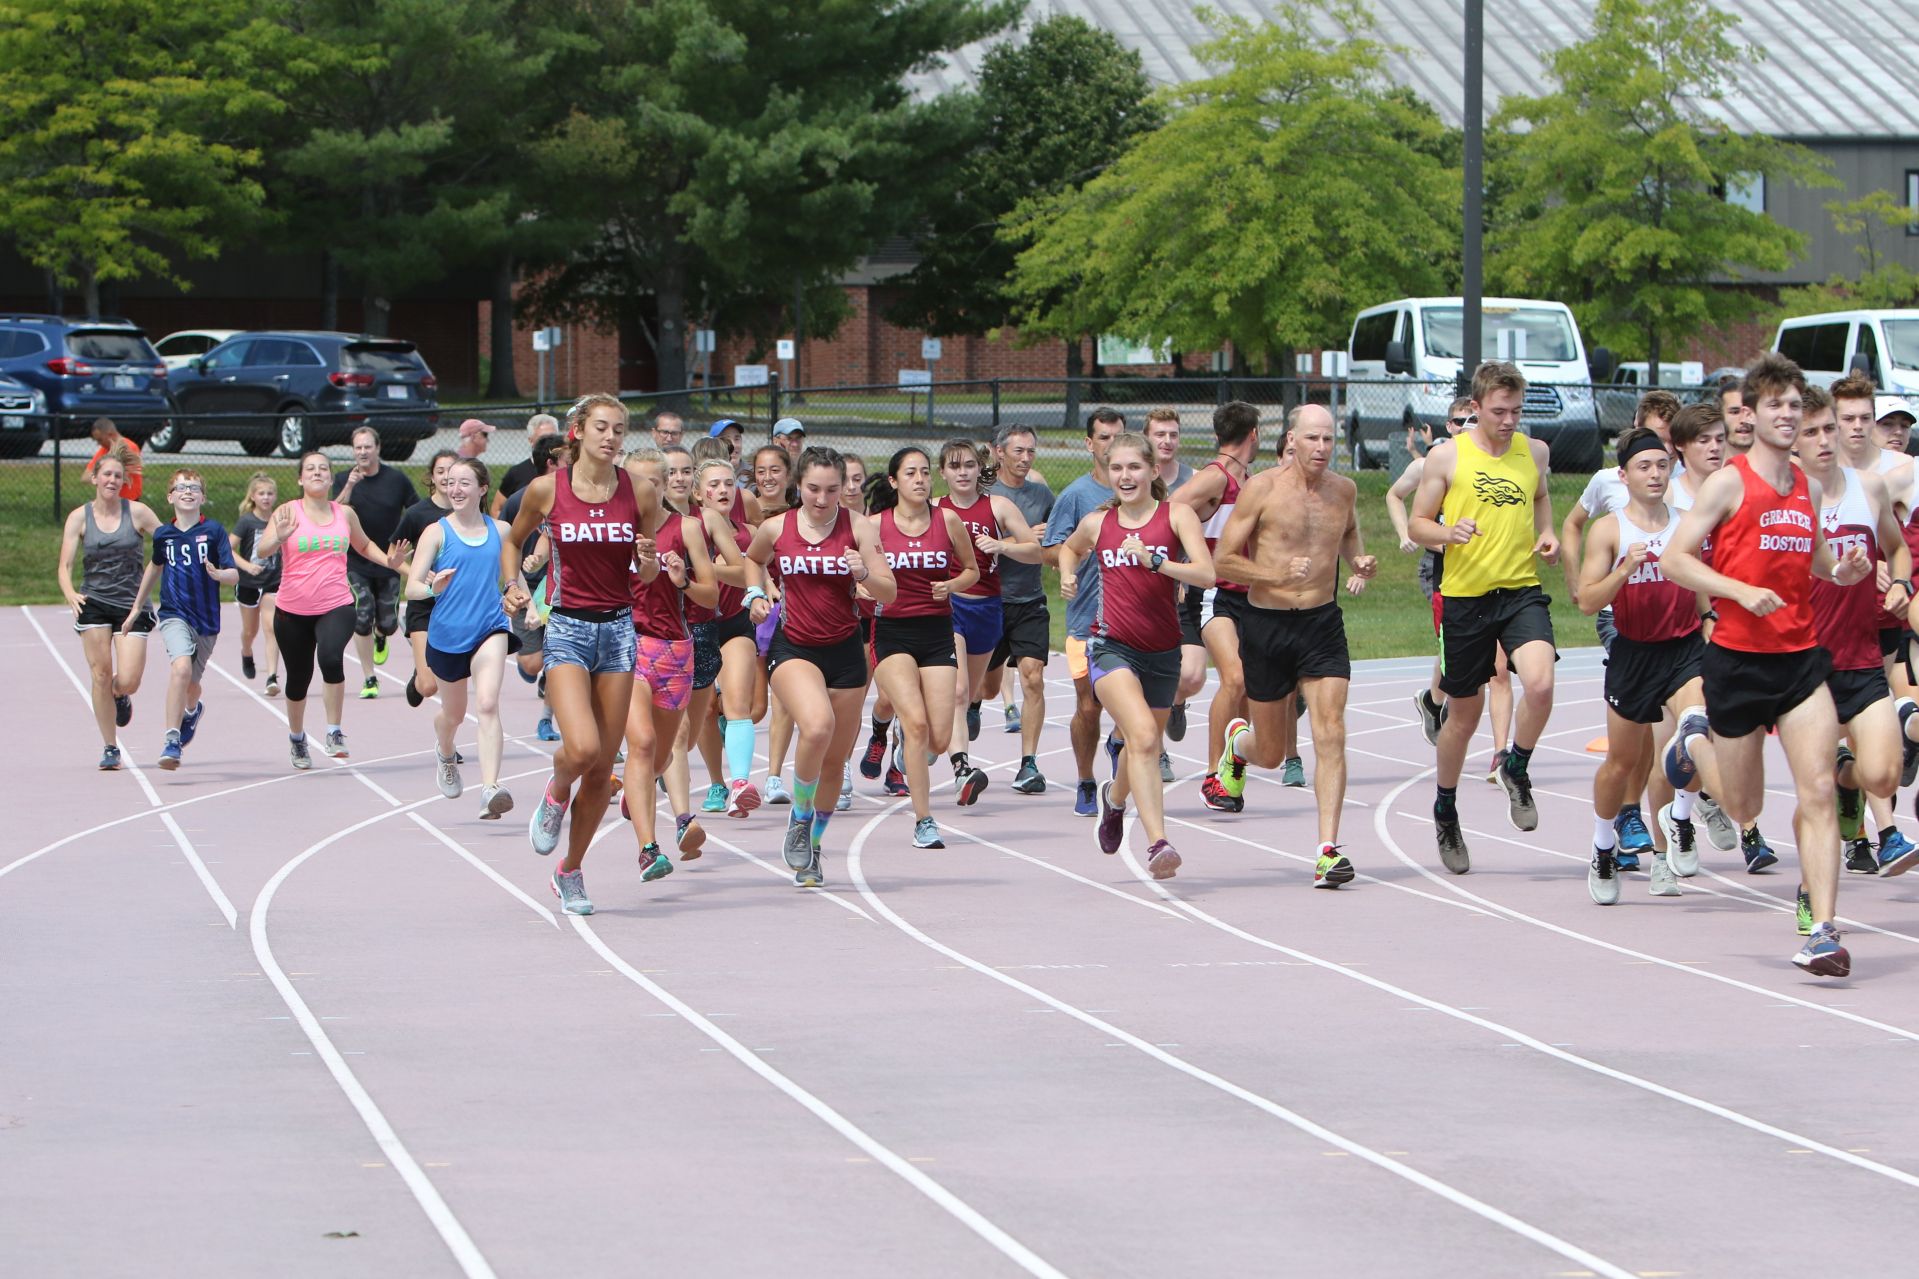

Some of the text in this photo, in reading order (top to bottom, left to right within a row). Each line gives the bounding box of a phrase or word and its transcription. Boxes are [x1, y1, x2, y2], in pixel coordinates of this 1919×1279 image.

[1760, 509, 1812, 532] GREATER
[560, 522, 634, 542] BATES
[1759, 534, 1812, 553] BOSTON
[166, 542, 208, 567] USA
[884, 551, 947, 570] BATES
[780, 555, 850, 575] BATES
